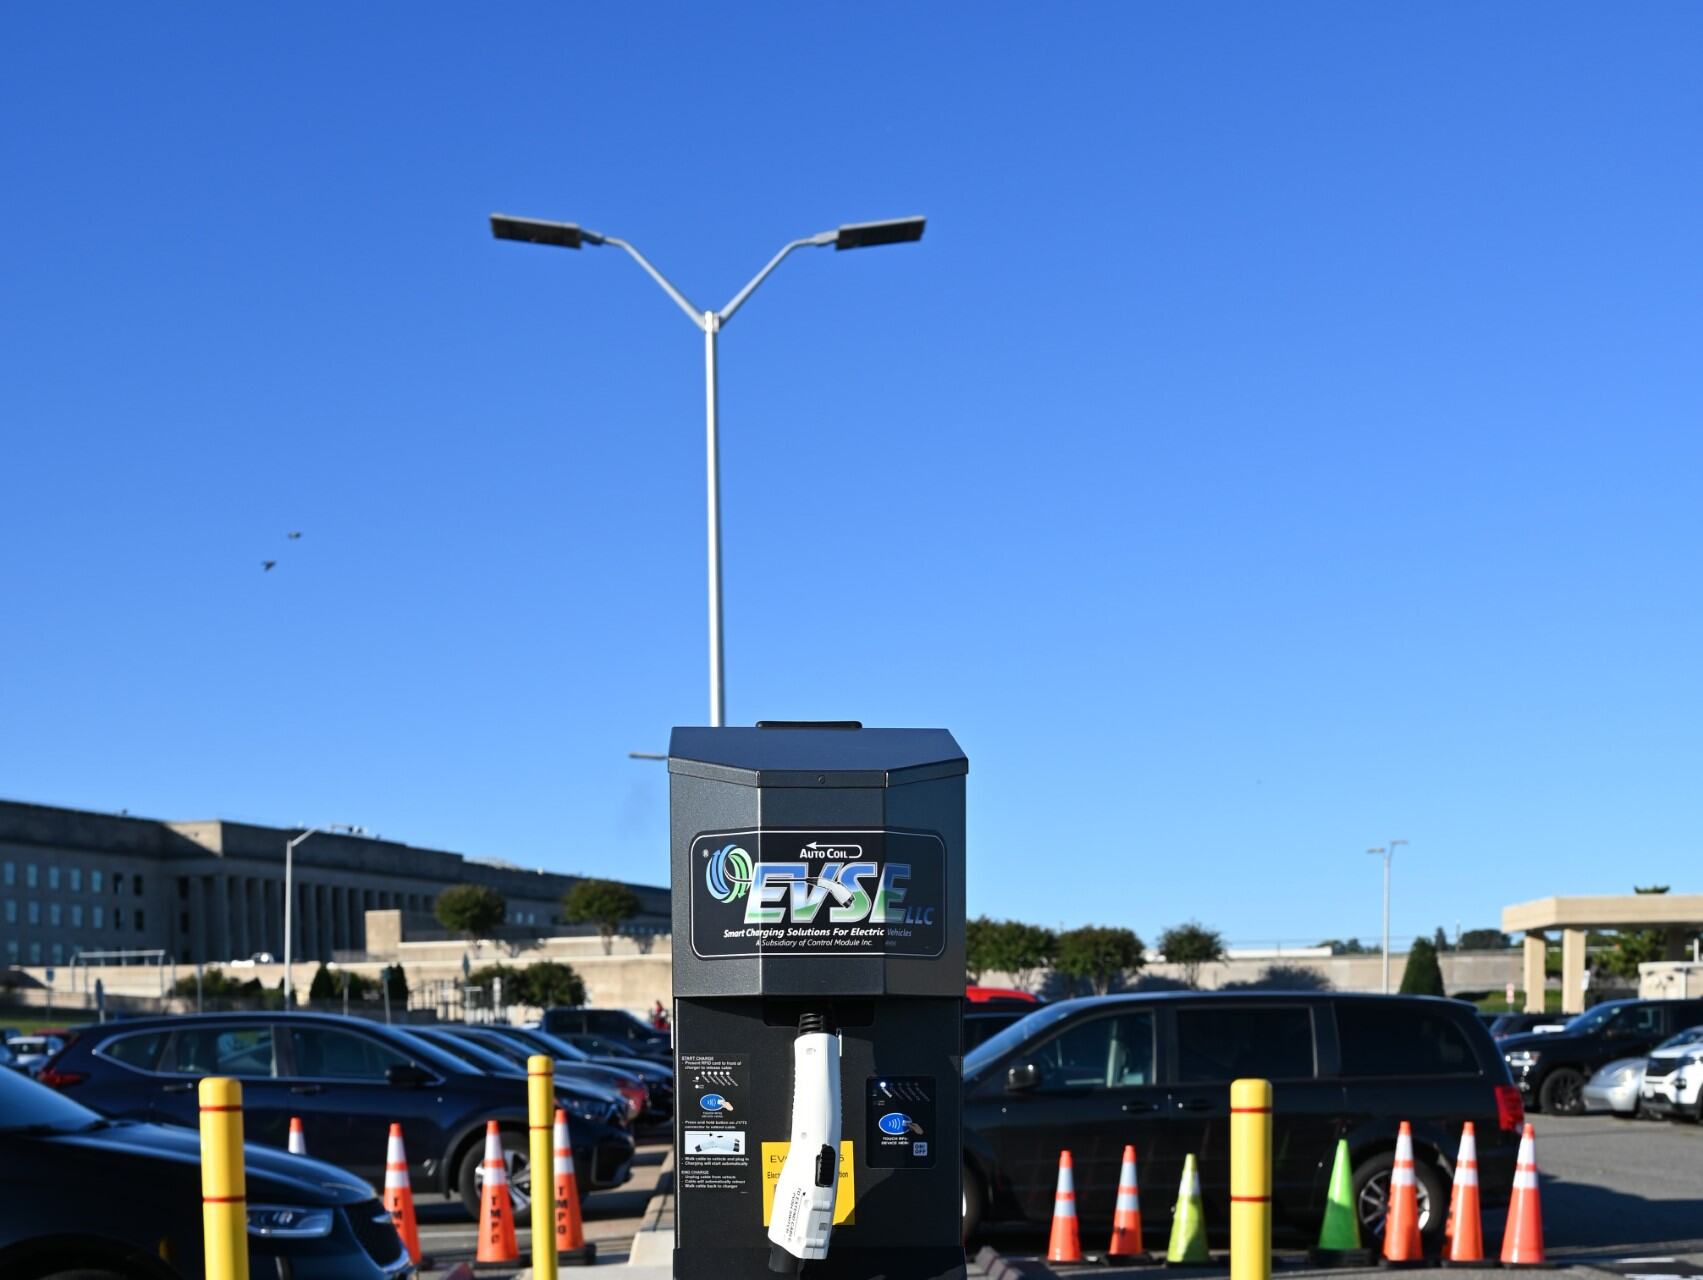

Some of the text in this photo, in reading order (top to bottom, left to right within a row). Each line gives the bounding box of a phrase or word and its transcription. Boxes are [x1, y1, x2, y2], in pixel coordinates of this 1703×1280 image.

[743, 862, 912, 924] EVSE
[904, 907, 935, 925] LLC
[723, 927, 912, 939] Smart Charging Solutions For Electric Vehicles
[761, 939, 796, 948] Subsidiary
[798, 939, 807, 947] of
[807, 939, 833, 947] Control
[833, 939, 860, 947] Module
